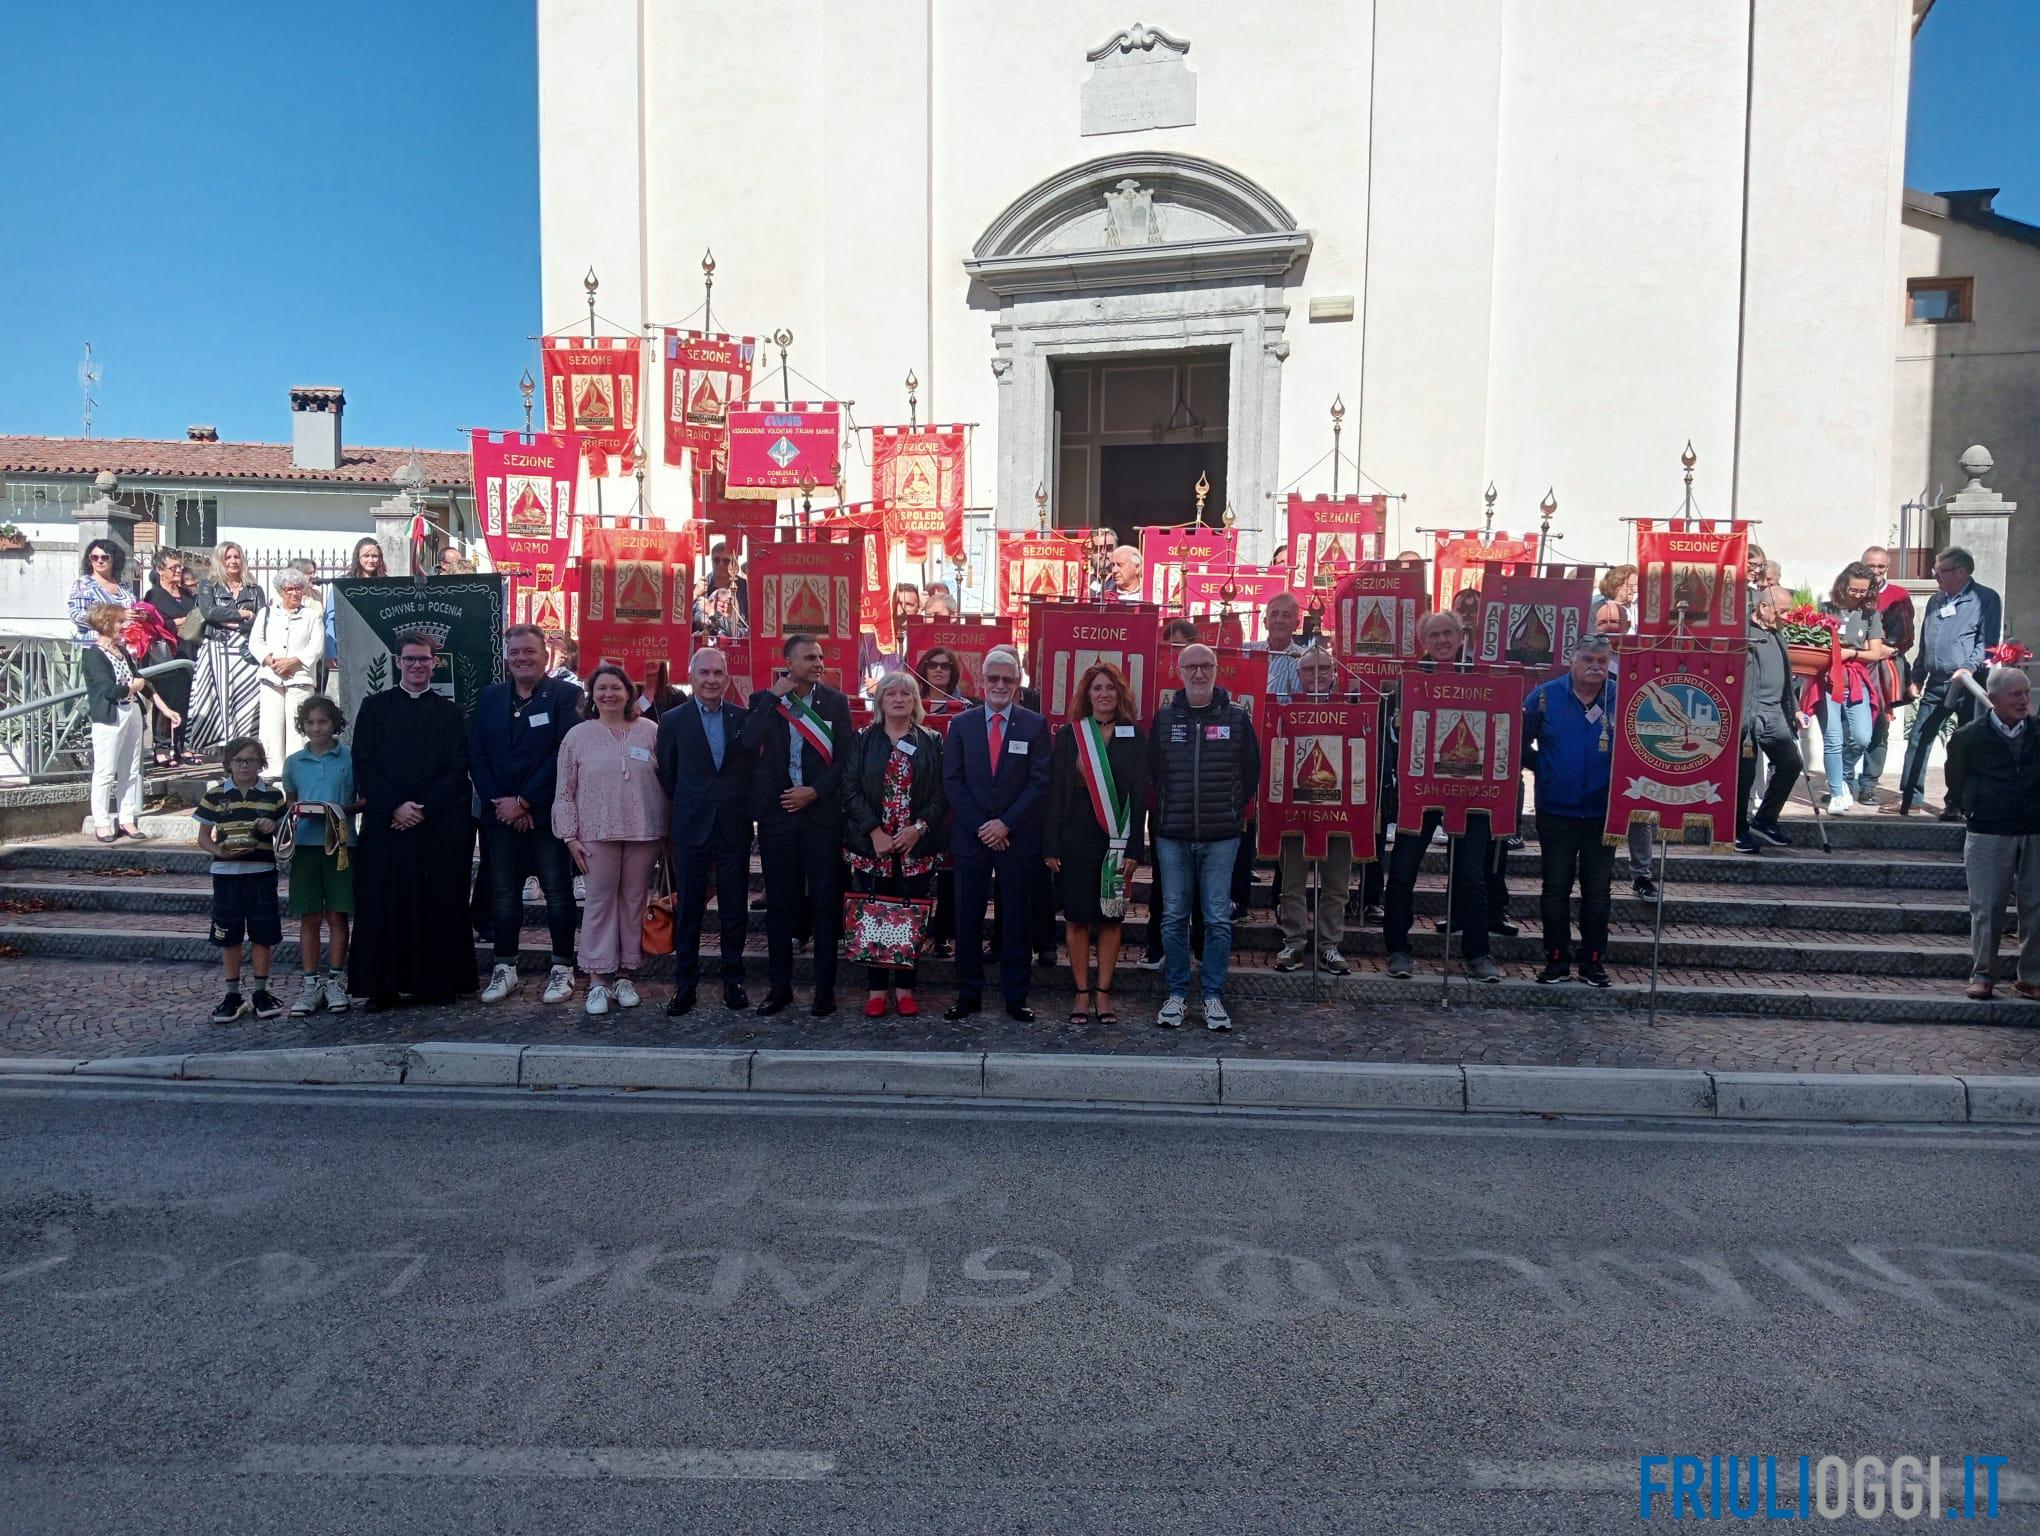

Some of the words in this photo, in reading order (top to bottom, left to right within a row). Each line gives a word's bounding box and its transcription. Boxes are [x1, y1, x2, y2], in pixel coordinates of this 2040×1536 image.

[568, 355, 614, 366] SEZIONE
[687, 349, 732, 364] SEZIONE
[554, 379, 565, 426] AFDS
[622, 379, 633, 426] AFDS
[673, 372, 682, 417] AFDS
[896, 442, 939, 453] SEZIONE
[503, 454, 556, 468] SEZIONE
[766, 469, 800, 477] COMUNALE
[488, 481, 501, 530] AFDS
[557, 486, 568, 533] AFDS
[1314, 511, 1361, 524] SEZIONE
[508, 541, 549, 554] VARMO
[1022, 546, 1066, 557] SEZIONE
[1167, 546, 1213, 557] SEONE
[1669, 540, 1719, 553] SEZIONE
[781, 553, 832, 566] SEZIONE
[592, 563, 604, 617] AFDS
[1355, 577, 1401, 590] SEZIONE
[673, 568, 686, 621] AFDS
[1648, 566, 1660, 621] AFDS
[1722, 569, 1735, 621] AFDS
[379, 602, 416, 620] COMVNE
[428, 601, 463, 619] POCENIA
[764, 578, 776, 636] AFDS
[837, 579, 850, 636] AFDS
[933, 632, 986, 645] SEZIONE
[1072, 626, 1128, 641] SEZIONE
[1484, 604, 1499, 657] AFDS
[1432, 685, 1493, 701] SEZIONE
[1289, 711, 1349, 725] SEZIONE
[1626, 692, 1646, 736] DONATORI
[1660, 675, 1714, 694] AZIENDALI
[1711, 692, 1723, 704] DI
[1717, 706, 1729, 748] SANGUE
[1629, 736, 1672, 771] AUTONOMO
[1674, 754, 1711, 772] GRUPPO
[1414, 783, 1439, 796] SAN
[1442, 783, 1501, 798] GERVASIO
[1643, 781, 1707, 799] GADAS
[1285, 809, 1349, 822] LATISANA
